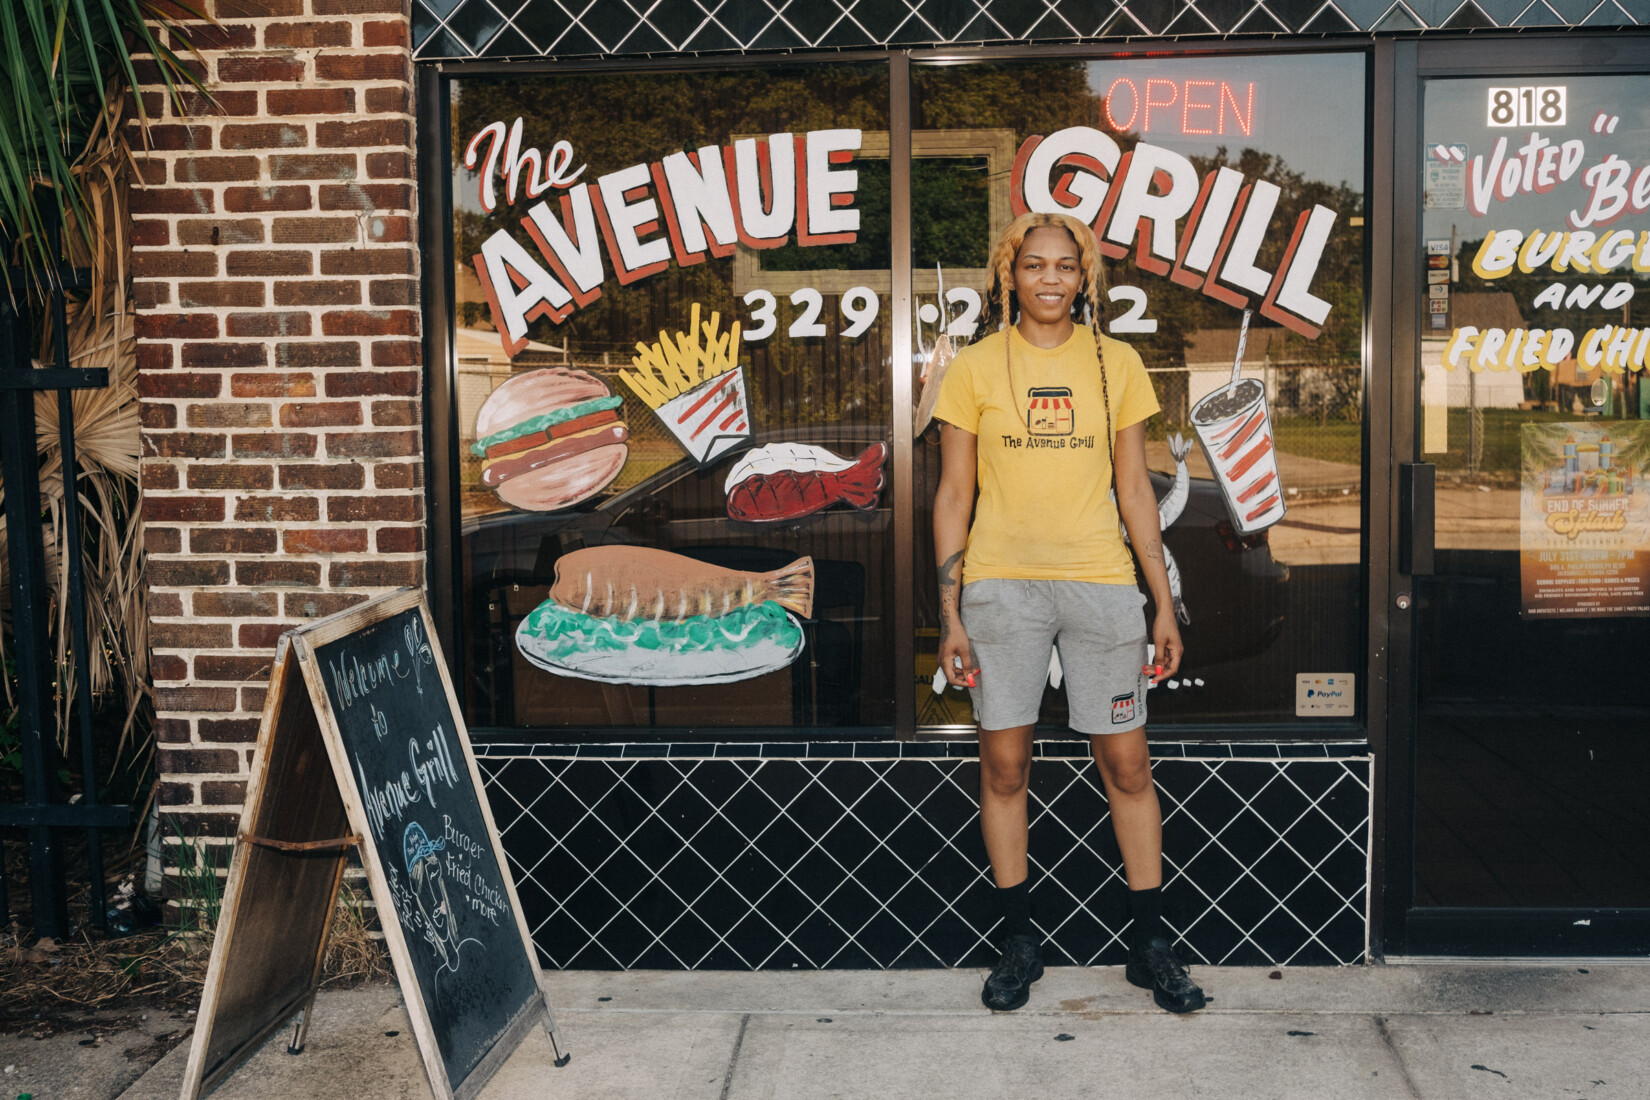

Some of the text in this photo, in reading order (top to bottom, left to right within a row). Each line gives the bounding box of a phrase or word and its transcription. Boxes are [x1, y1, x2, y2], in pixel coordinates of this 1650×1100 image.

[1105, 77, 1255, 137] OPEN
[1490, 90, 1563, 125] 818
[465, 116, 587, 213] The
[473, 129, 862, 358] AVENUE
[1010, 126, 1337, 340] GRILL
[742, 286, 879, 342] 329
[1534, 282, 1635, 311] AND
[1442, 325, 1575, 373] FRIED
[1002, 434, 1095, 449] The Avenue Grill
[1545, 508, 1627, 540] Splash
[1548, 498, 1629, 512] END OF SUMMER
[1540, 551, 1558, 562] JULY
[1560, 550, 1578, 562] 31ST
[1617, 549, 1635, 560] 7PM
[329, 649, 410, 711] Welcome
[1317, 690, 1342, 698] PayPal
[371, 703, 388, 742] to
[354, 720, 459, 845] Avenue Grill
[442, 814, 485, 868] Burger
[472, 898, 499, 926] more
